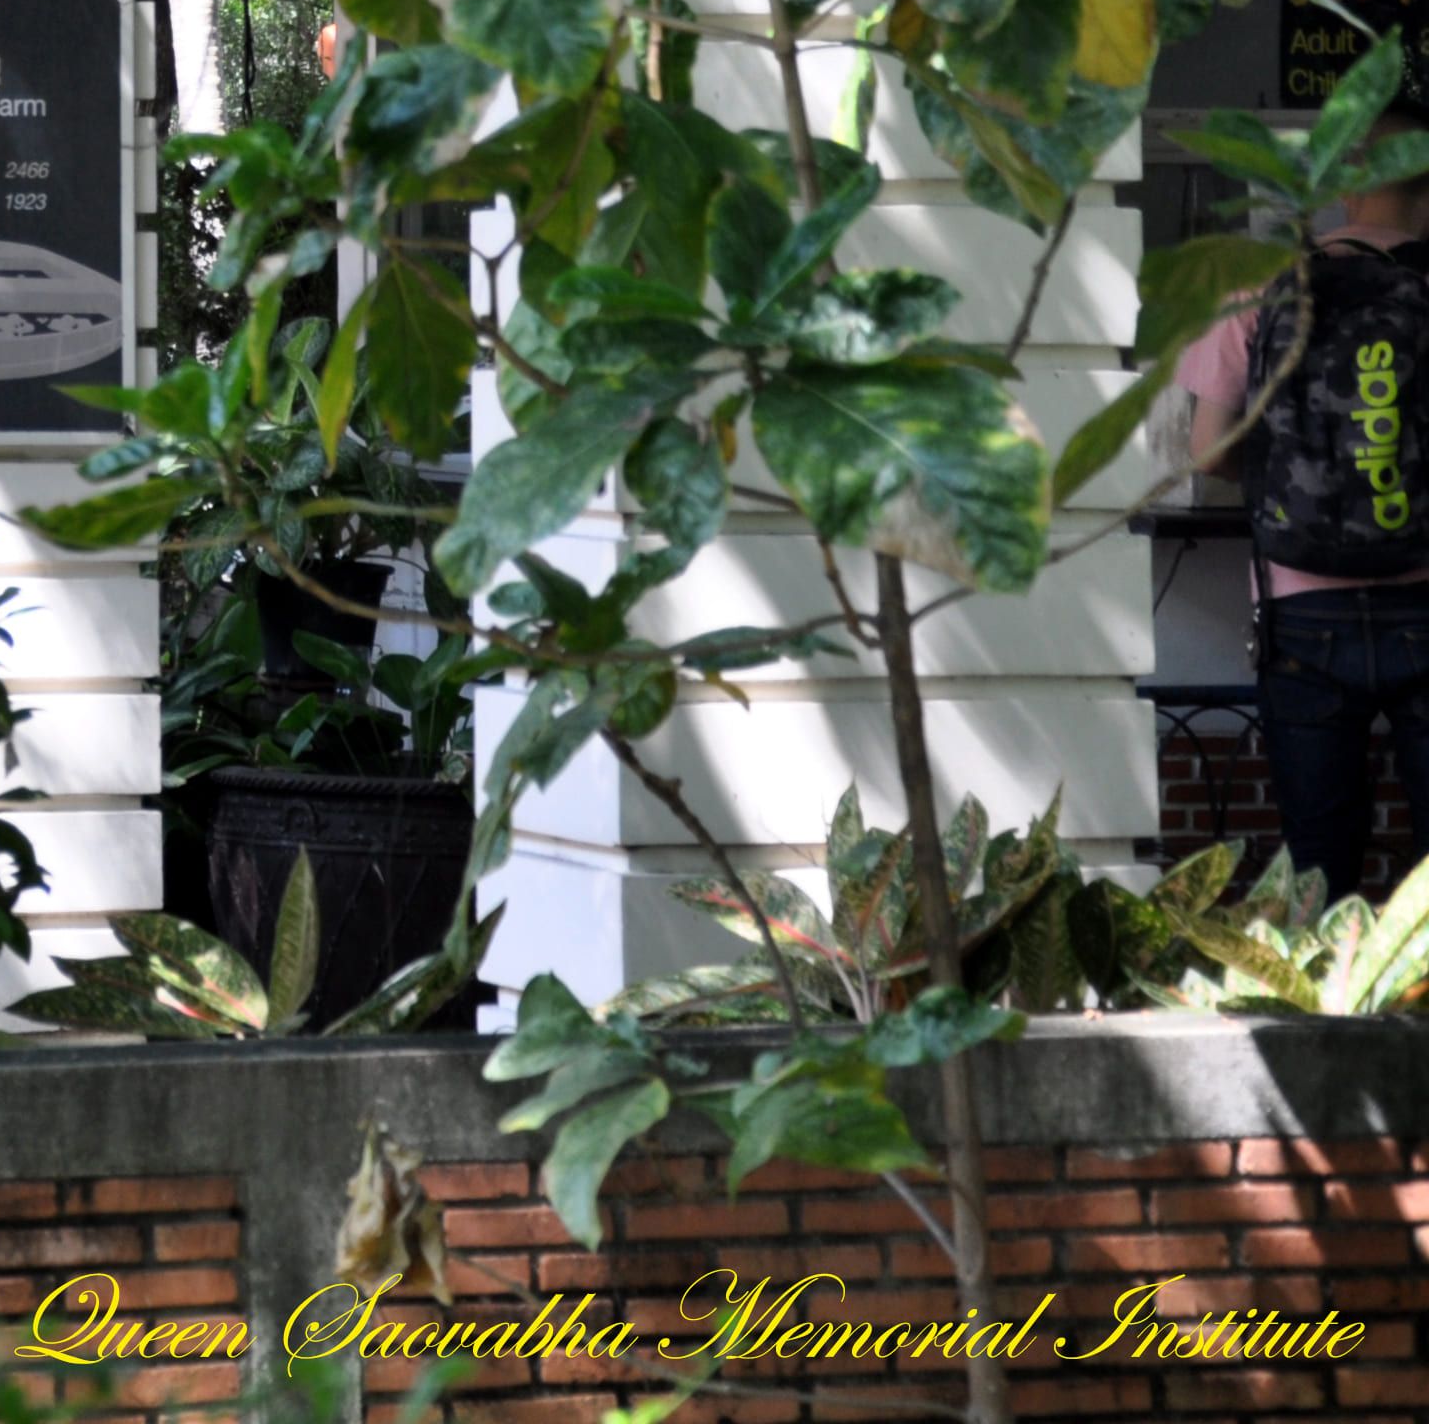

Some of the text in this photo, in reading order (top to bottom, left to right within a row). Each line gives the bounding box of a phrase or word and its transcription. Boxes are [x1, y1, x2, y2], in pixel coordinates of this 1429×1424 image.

[1290, 28, 1357, 55] Adult
[5, 161, 50, 179] 2466
[4, 193, 49, 211] 1923
[1350, 340, 1410, 531] adidas
